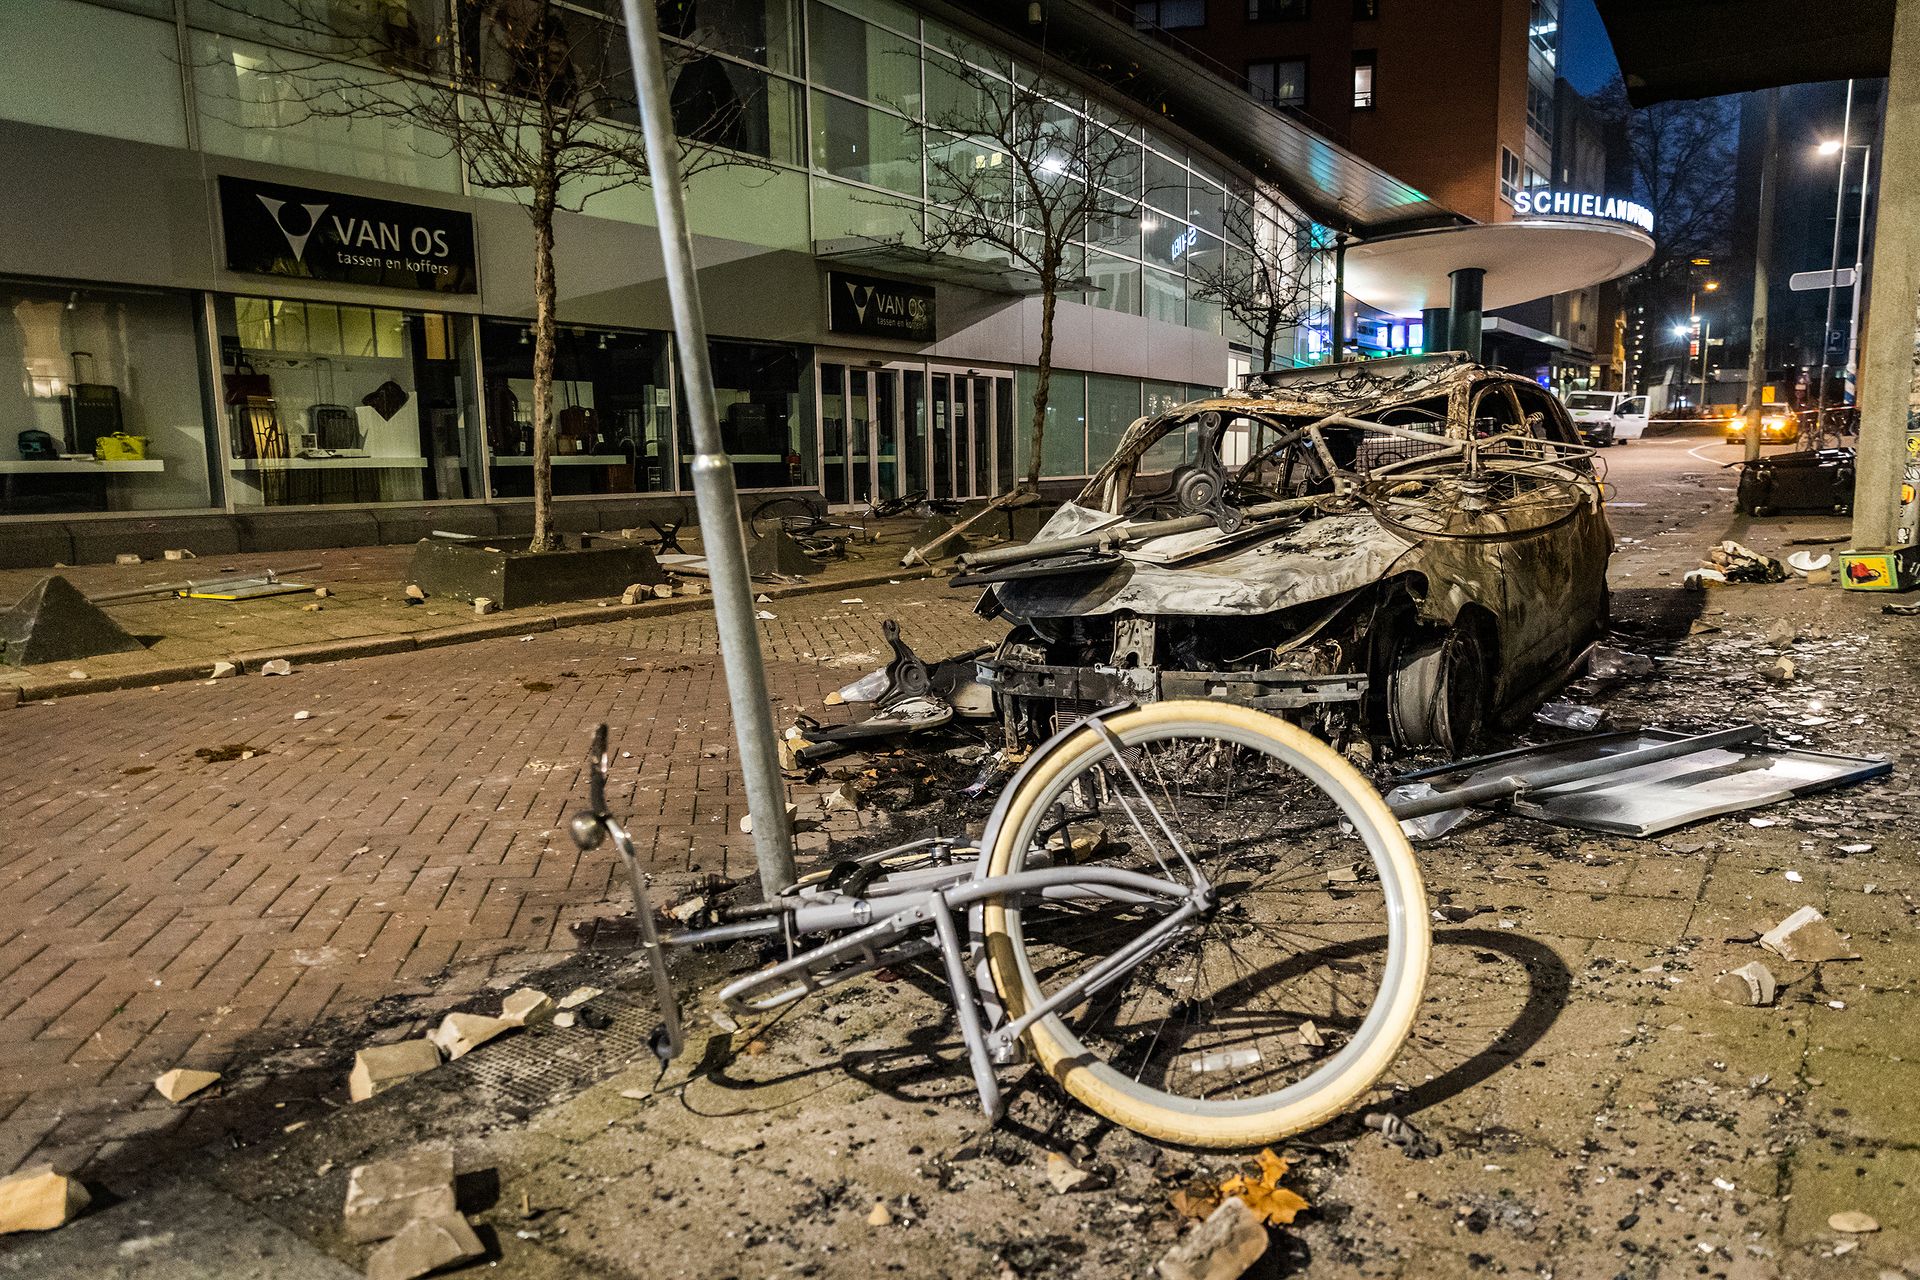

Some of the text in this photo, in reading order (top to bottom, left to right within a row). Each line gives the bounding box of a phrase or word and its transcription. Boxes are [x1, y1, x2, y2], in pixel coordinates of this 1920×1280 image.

[332, 215, 449, 258] VAN OS
[337, 251, 449, 275] tassen en koffers
[875, 293, 925, 318] VAN OS
[1830, 332, 1841, 345] P
